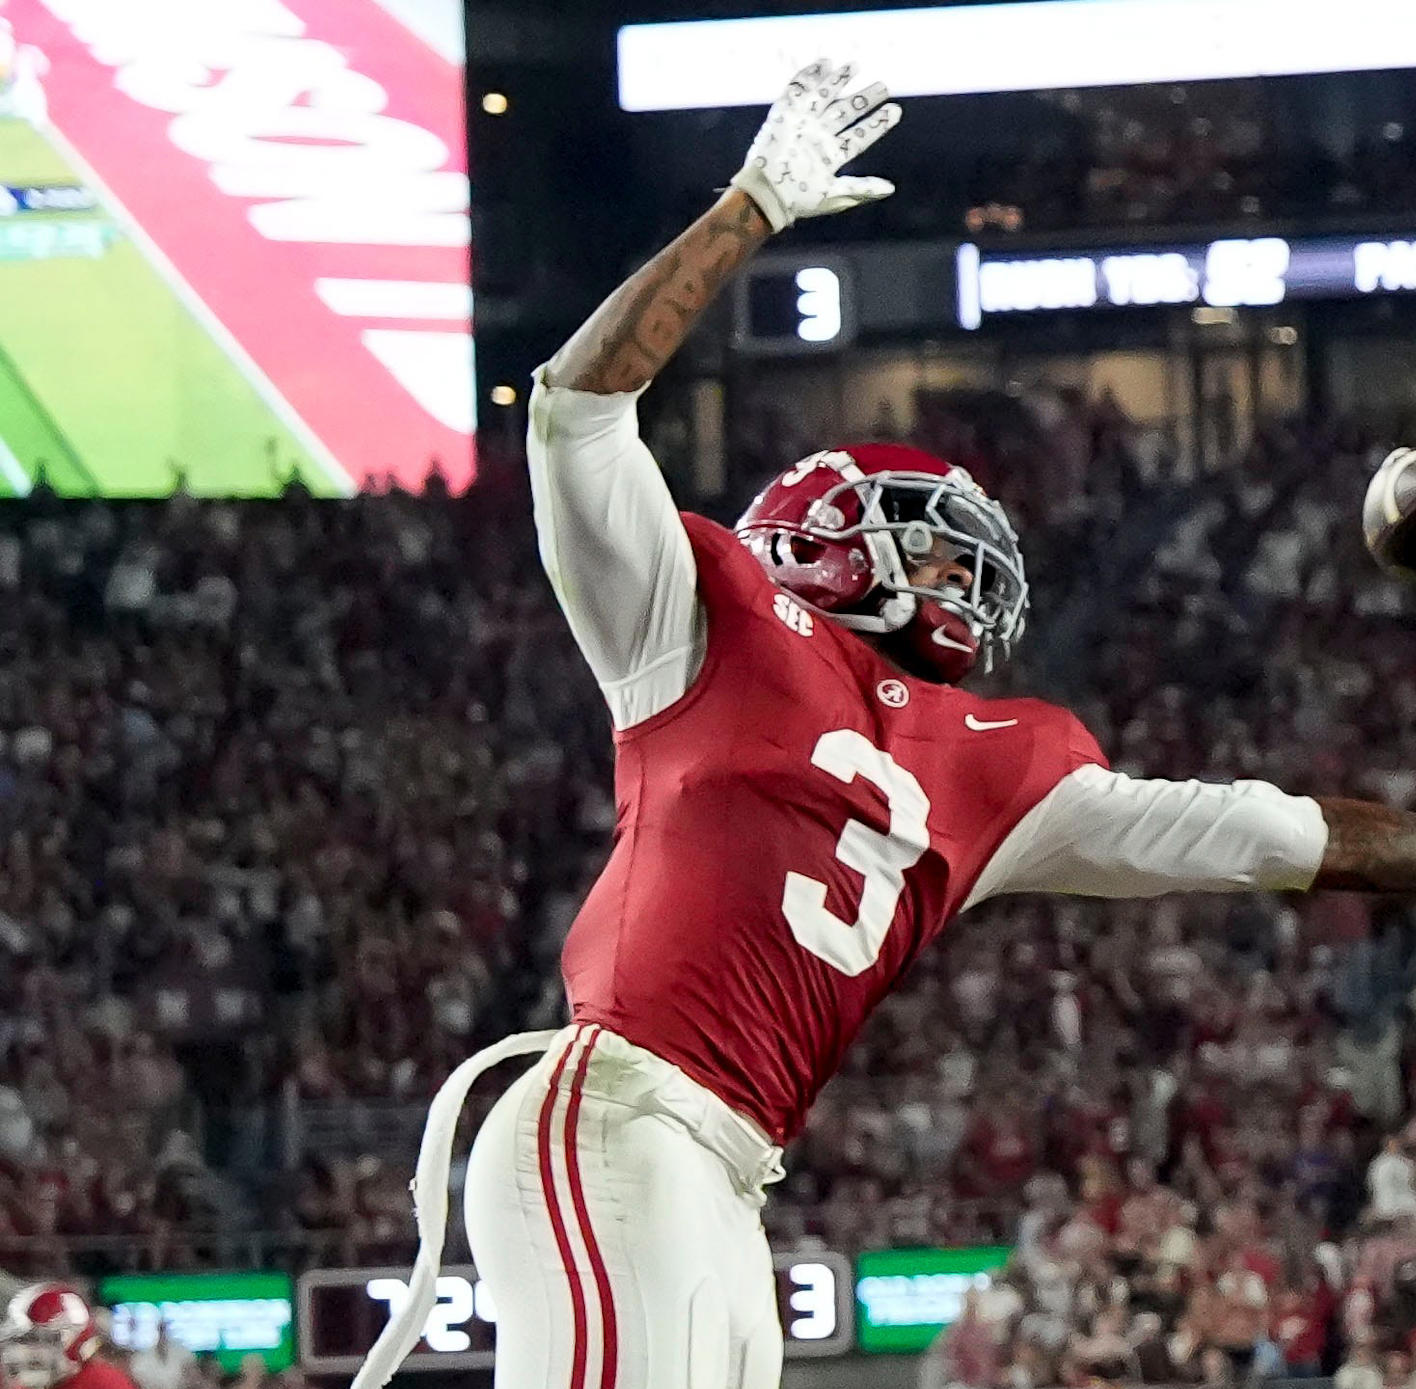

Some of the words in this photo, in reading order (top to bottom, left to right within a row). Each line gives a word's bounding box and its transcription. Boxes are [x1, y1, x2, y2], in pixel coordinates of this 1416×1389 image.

[794, 266, 841, 343] 3
[772, 592, 815, 638] SEC
[781, 728, 931, 979] 3
[790, 1263, 836, 1340] 3
